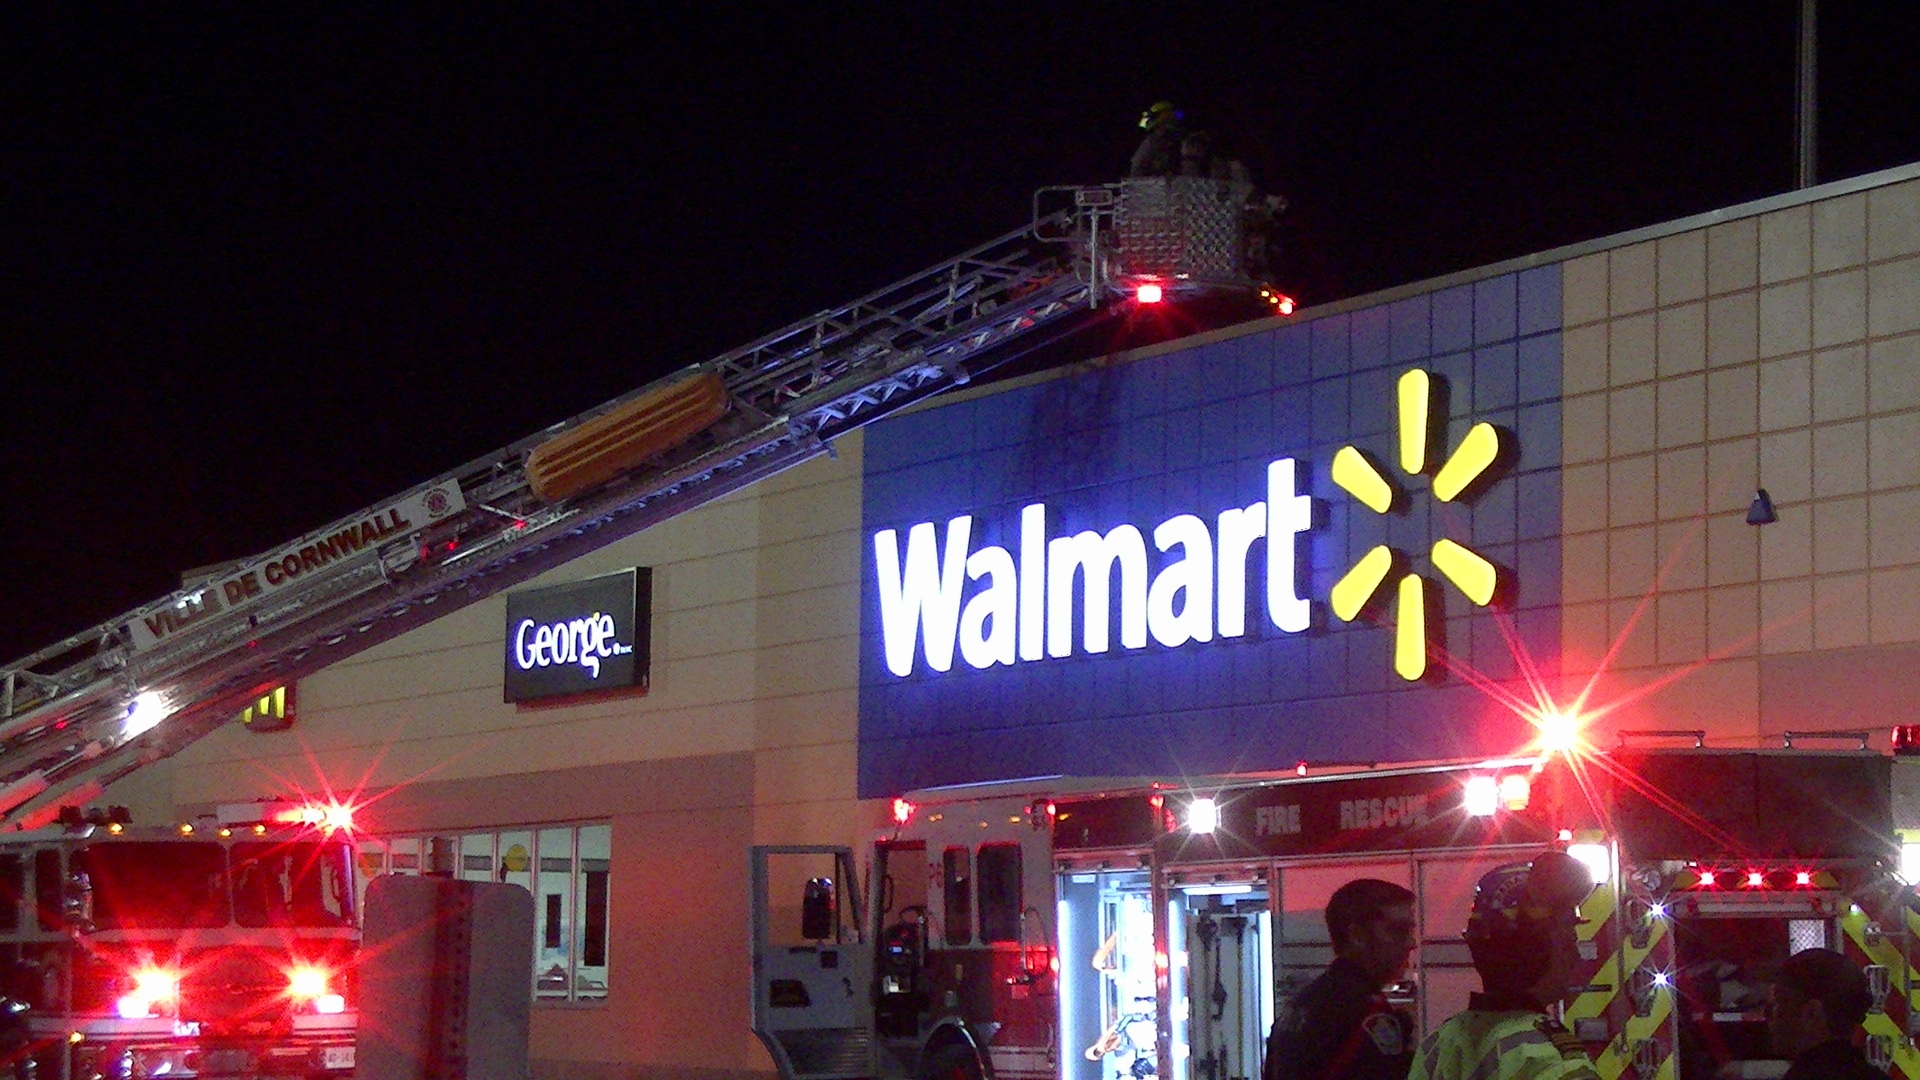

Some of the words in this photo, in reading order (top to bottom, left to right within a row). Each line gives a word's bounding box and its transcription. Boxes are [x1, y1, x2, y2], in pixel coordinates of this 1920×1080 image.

[224, 572, 262, 606] DE
[265, 508, 412, 586] CORNWALL
[874, 458, 1311, 677] Walmart
[1256, 804, 1301, 836] FIRE
[1340, 796, 1429, 830] RESCUE
